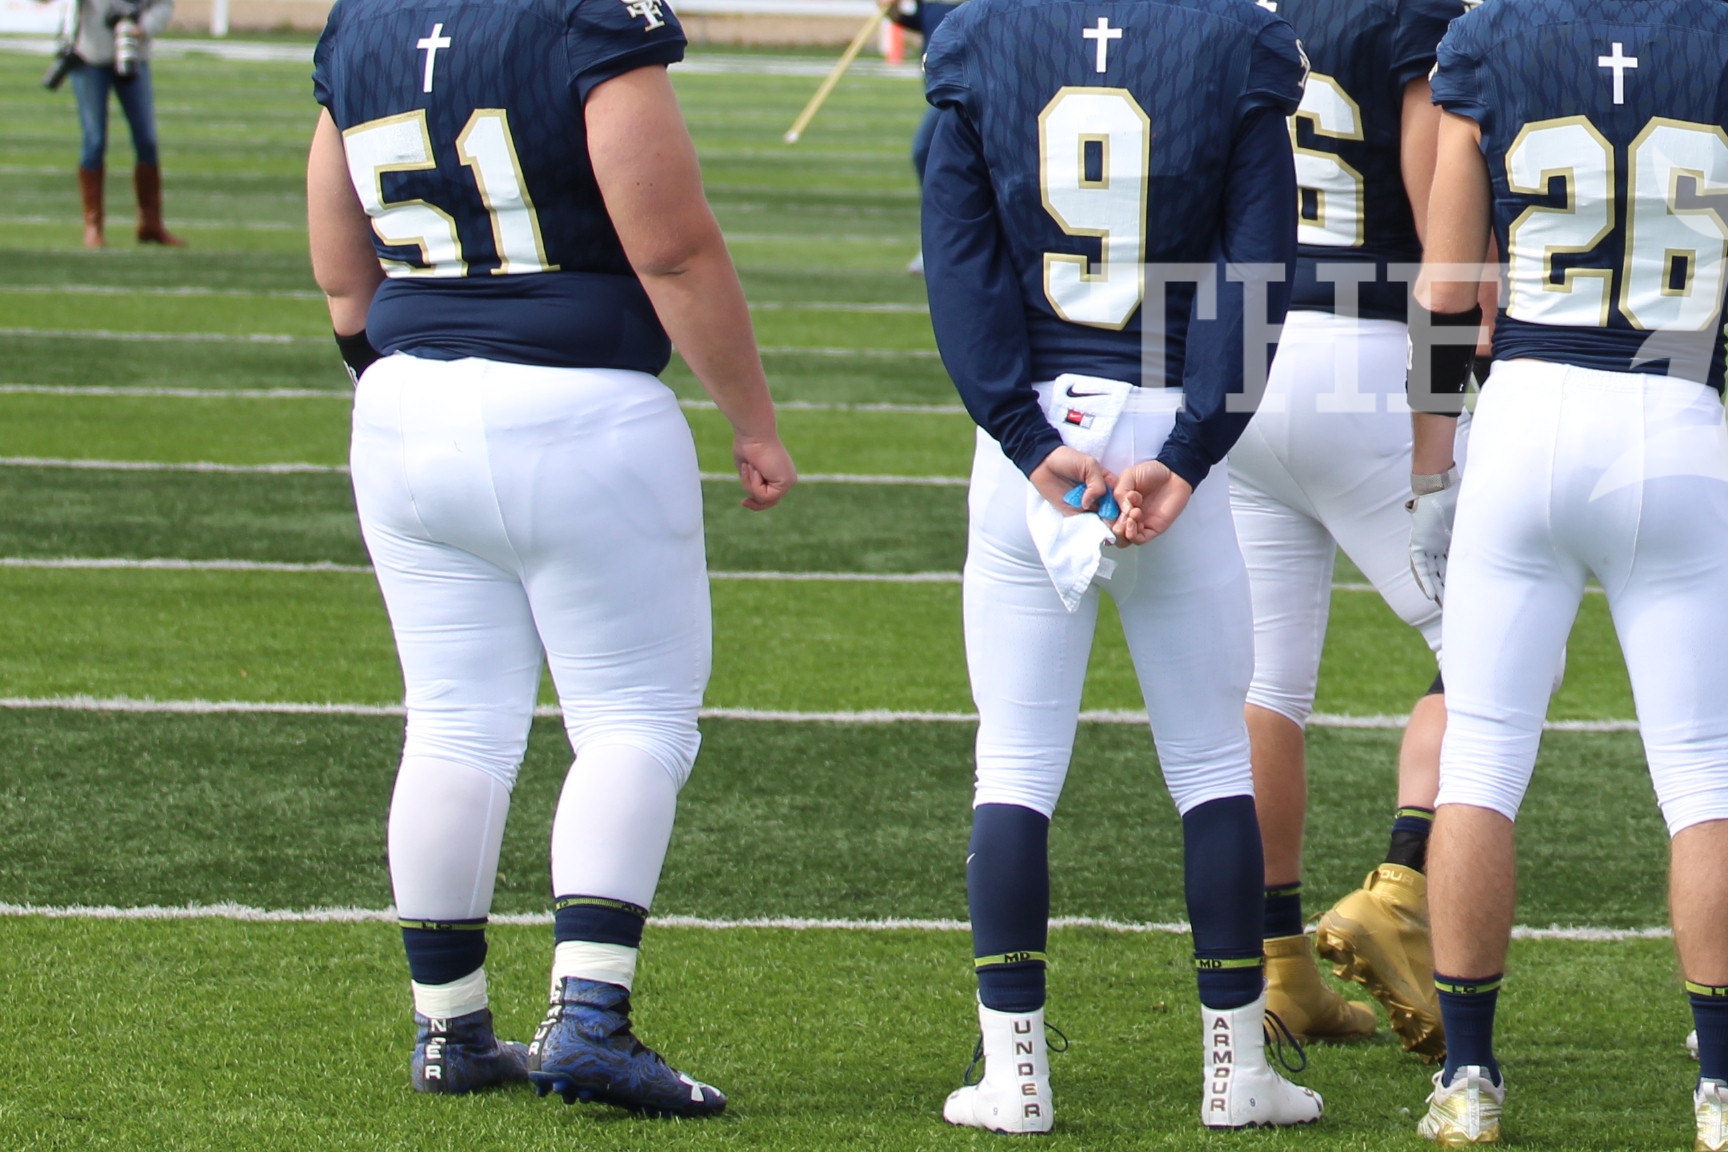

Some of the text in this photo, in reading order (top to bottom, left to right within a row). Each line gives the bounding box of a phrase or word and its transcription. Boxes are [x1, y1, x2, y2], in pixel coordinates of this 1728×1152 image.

[342, 108, 561, 279] 51
[1038, 85, 1151, 330] 9
[1288, 71, 1365, 248] 6
[1004, 952, 1030, 963] MD
[1200, 959, 1222, 969] MD
[425, 1018, 447, 1079] NER
[1013, 1019, 1041, 1119] UNDER
[1210, 1016, 1233, 1112] ARMOUR
